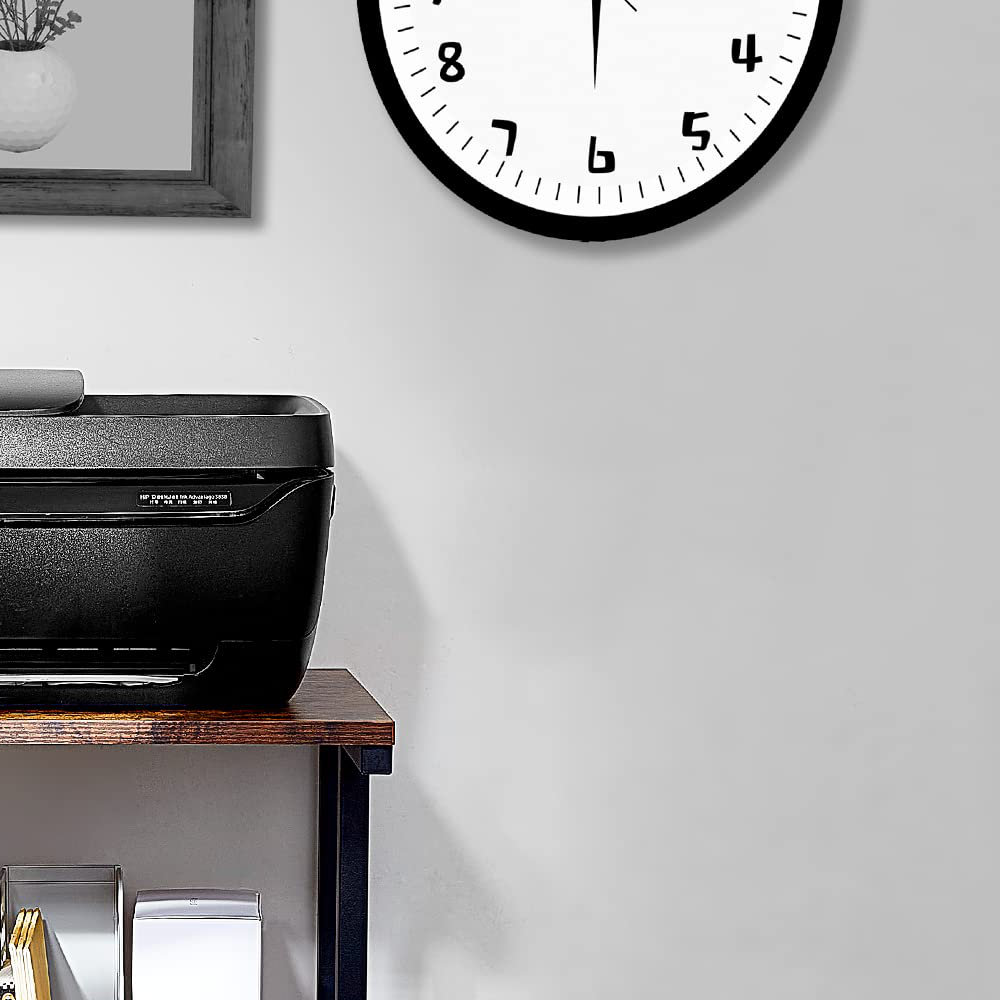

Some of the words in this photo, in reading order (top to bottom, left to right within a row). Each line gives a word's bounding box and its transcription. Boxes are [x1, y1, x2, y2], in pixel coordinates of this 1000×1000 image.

[437, 41, 466, 83] 8
[731, 33, 763, 73] 4
[491, 118, 518, 157] 7
[681, 111, 711, 151] 5
[588, 135, 616, 174] 6
